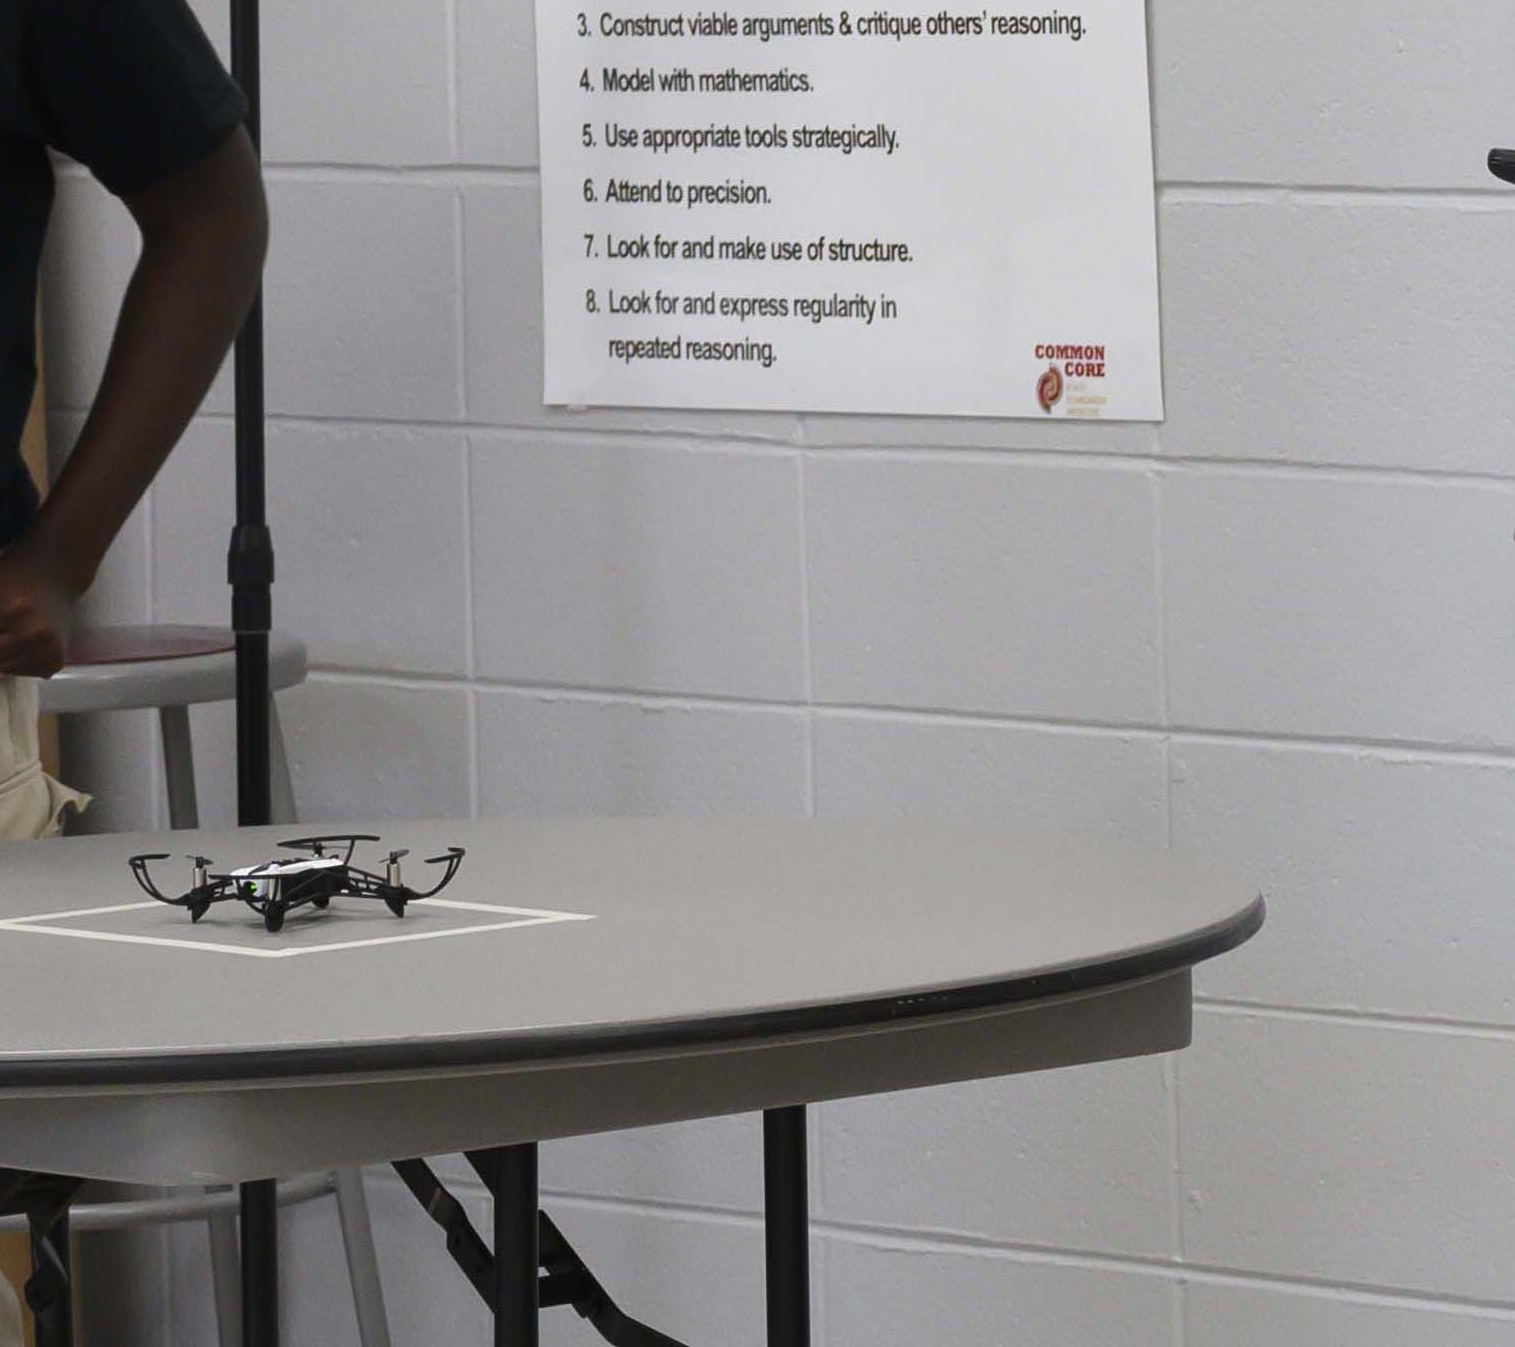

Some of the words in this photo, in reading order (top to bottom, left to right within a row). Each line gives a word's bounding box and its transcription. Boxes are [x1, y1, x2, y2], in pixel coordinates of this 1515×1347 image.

[577, 13, 591, 37] 3.
[600, 12, 684, 36] Construct
[688, 12, 738, 36] viable
[743, 13, 834, 42] arguments
[839, 11, 852, 35] &
[857, 11, 921, 41] critique
[991, 9, 1086, 41] reasoning.
[580, 68, 594, 91] 4.
[603, 68, 654, 92] Model
[659, 68, 694, 92] with
[699, 68, 813, 92] mathematics.
[583, 123, 596, 147] 5.
[605, 123, 638, 147] Use
[643, 124, 741, 153] appropriate
[745, 124, 788, 148] tools
[792, 124, 899, 154] strategically.
[584, 178, 597, 202] 6.
[605, 179, 661, 202] Attend
[666, 181, 683, 203] to
[688, 180, 771, 209] precision.
[584, 234, 598, 257] 7.
[608, 234, 649, 258] Look
[654, 234, 678, 259] for
[682, 236, 714, 259] and
[719, 236, 766, 260] make
[771, 243, 802, 260] use
[807, 236, 825, 261] of
[829, 239, 912, 262] structure.
[586, 289, 600, 313] 8.
[609, 290, 651, 314] Look
[655, 290, 679, 314] for
[683, 292, 715, 315] and
[720, 298, 789, 322] express
[794, 293, 876, 325] regularity
[881, 294, 897, 318] in
[609, 336, 681, 364] repeated
[686, 337, 776, 368] reasoning.
[1035, 345, 1104, 360] COMMON
[1065, 362, 1105, 377] CORE
